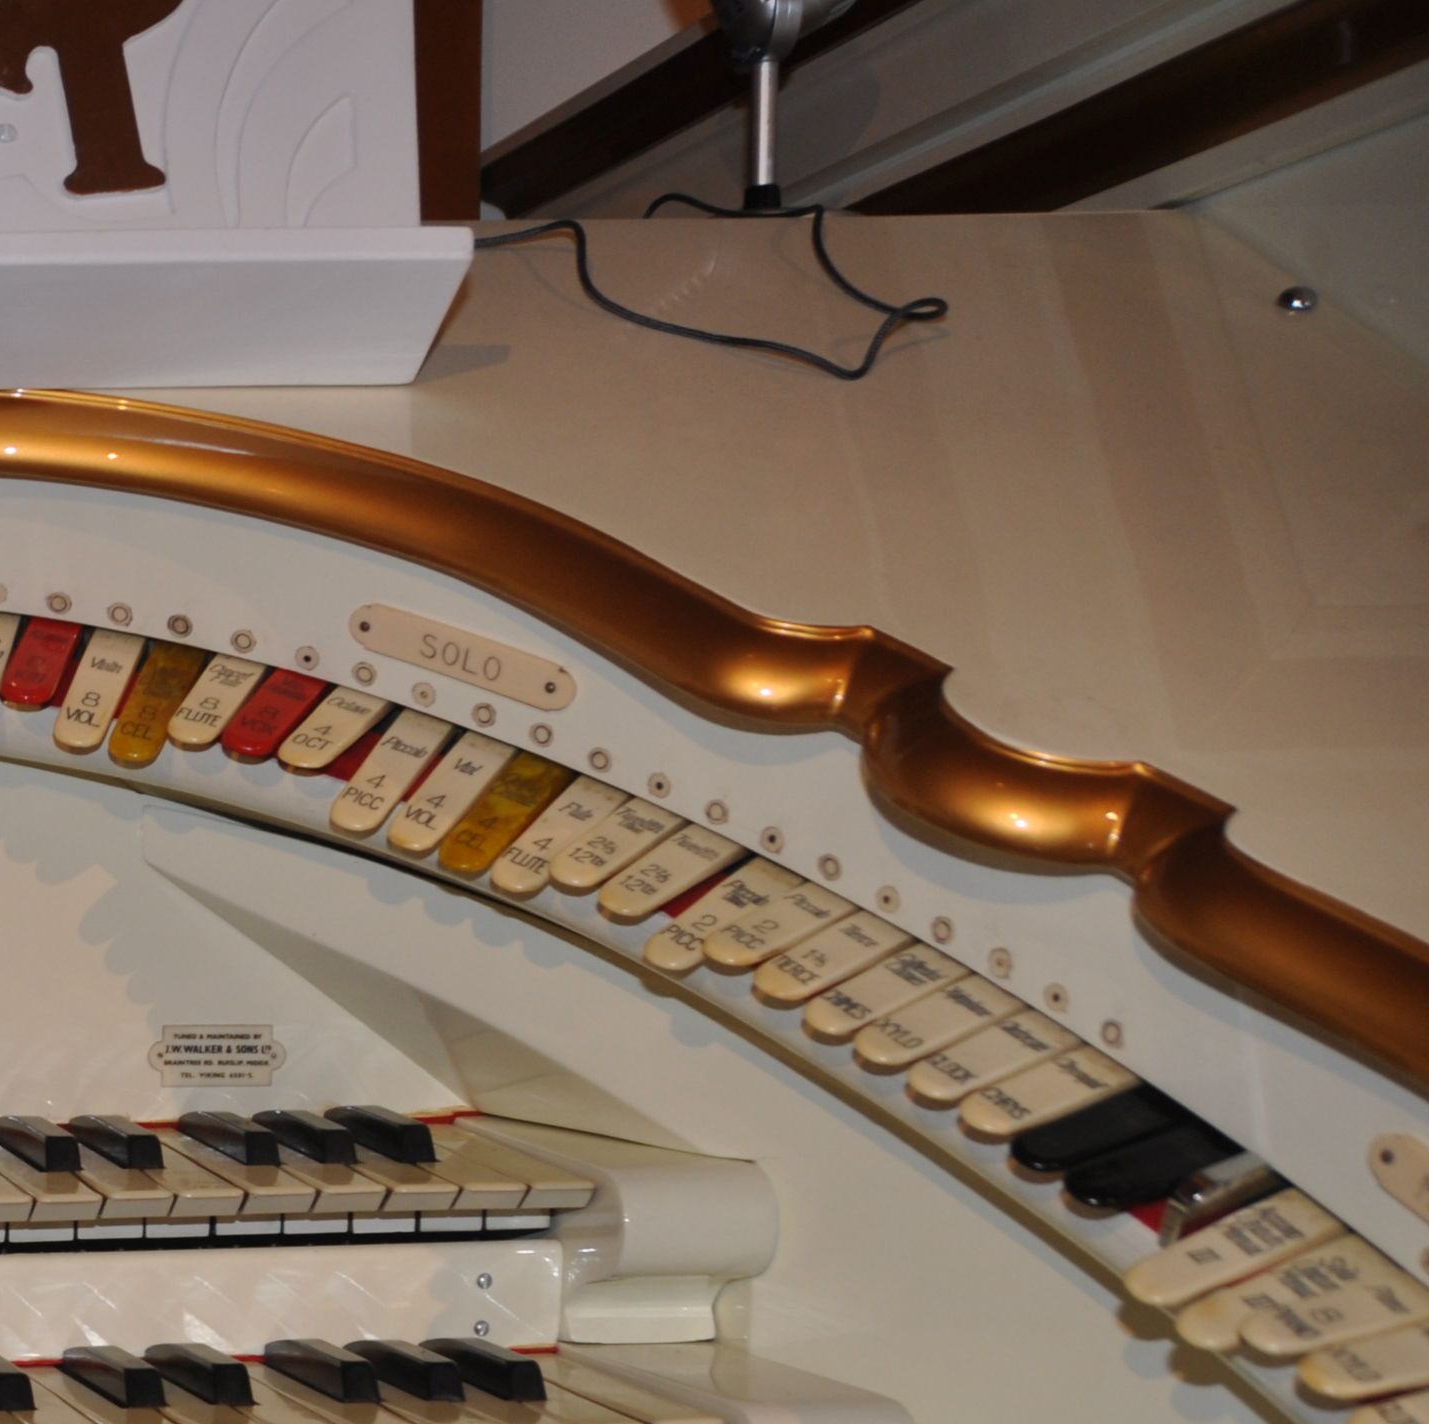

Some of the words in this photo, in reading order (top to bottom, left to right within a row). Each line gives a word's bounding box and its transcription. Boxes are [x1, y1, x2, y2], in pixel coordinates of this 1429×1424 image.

[90, 655, 124, 674] Violin
[419, 632, 503, 682] SOLO
[80, 691, 102, 708] 8
[198, 696, 220, 710] 8
[326, 695, 373, 716] Octave
[65, 706, 101, 728] VIOL
[138, 705, 158, 721] 8
[176, 707, 223, 729] FLUTE
[119, 721, 153, 742] CEL
[311, 724, 332, 738] 4
[291, 733, 334, 752] OCT
[380, 735, 429, 760] Piccolo
[453, 757, 485, 777] Viol
[365, 774, 387, 790] 4
[342, 787, 386, 812] PICC
[426, 793, 447, 809] 4
[405, 804, 439, 831] VIOL
[559, 800, 594, 822] Flute
[533, 836, 555, 852] 4
[506, 847, 552, 875] FLUTE
[691, 913, 718, 932] 2
[752, 919, 780, 935] 2
[660, 922, 706, 953] PICC
[720, 924, 766, 950] PICC
[879, 1018, 925, 1050] XYLO
[236, 1044, 259, 1054] SONS
